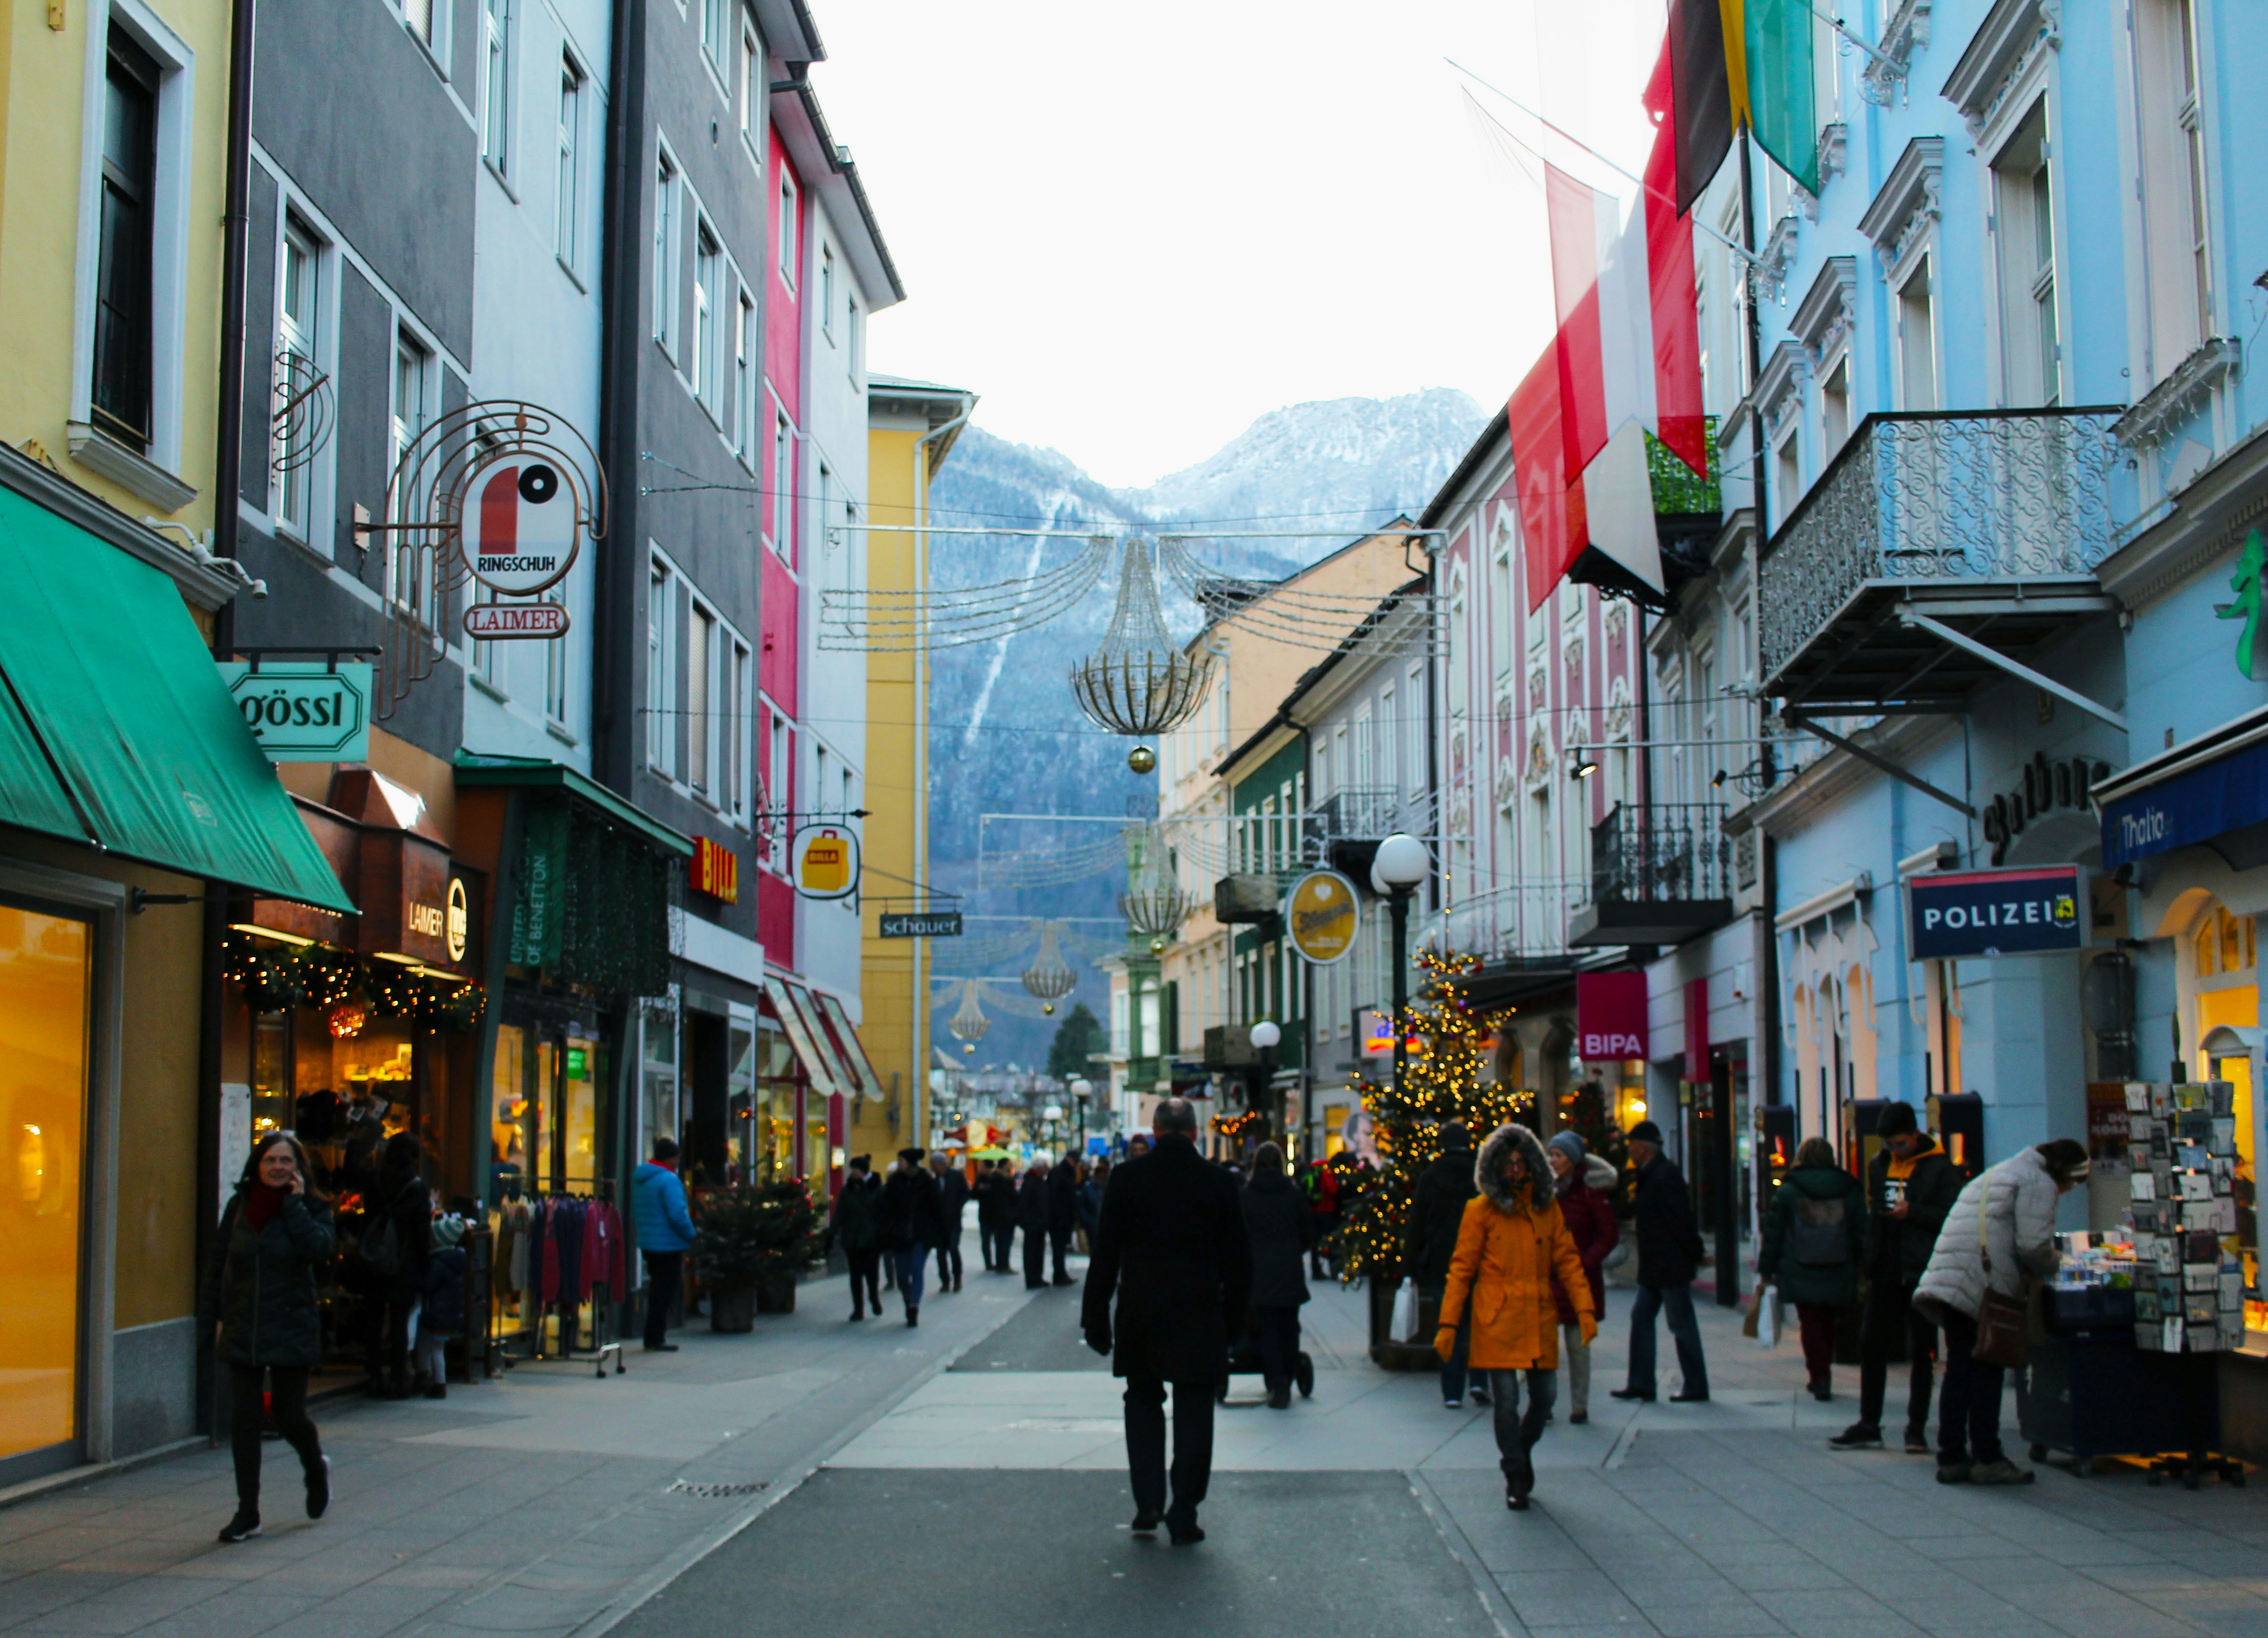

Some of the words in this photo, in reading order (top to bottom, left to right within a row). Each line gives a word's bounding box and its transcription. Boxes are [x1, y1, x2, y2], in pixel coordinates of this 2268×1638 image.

[478, 557, 555, 572] RINGSCHUH
[472, 610, 560, 630] LAIMER
[240, 689, 342, 737] gössl
[529, 855, 546, 940] BENETTON
[408, 901, 443, 938] LAIMER
[884, 917, 958, 935] schauer
[1924, 900, 2052, 931] POLIZEI
[1585, 1033, 1643, 1055] BIPA
